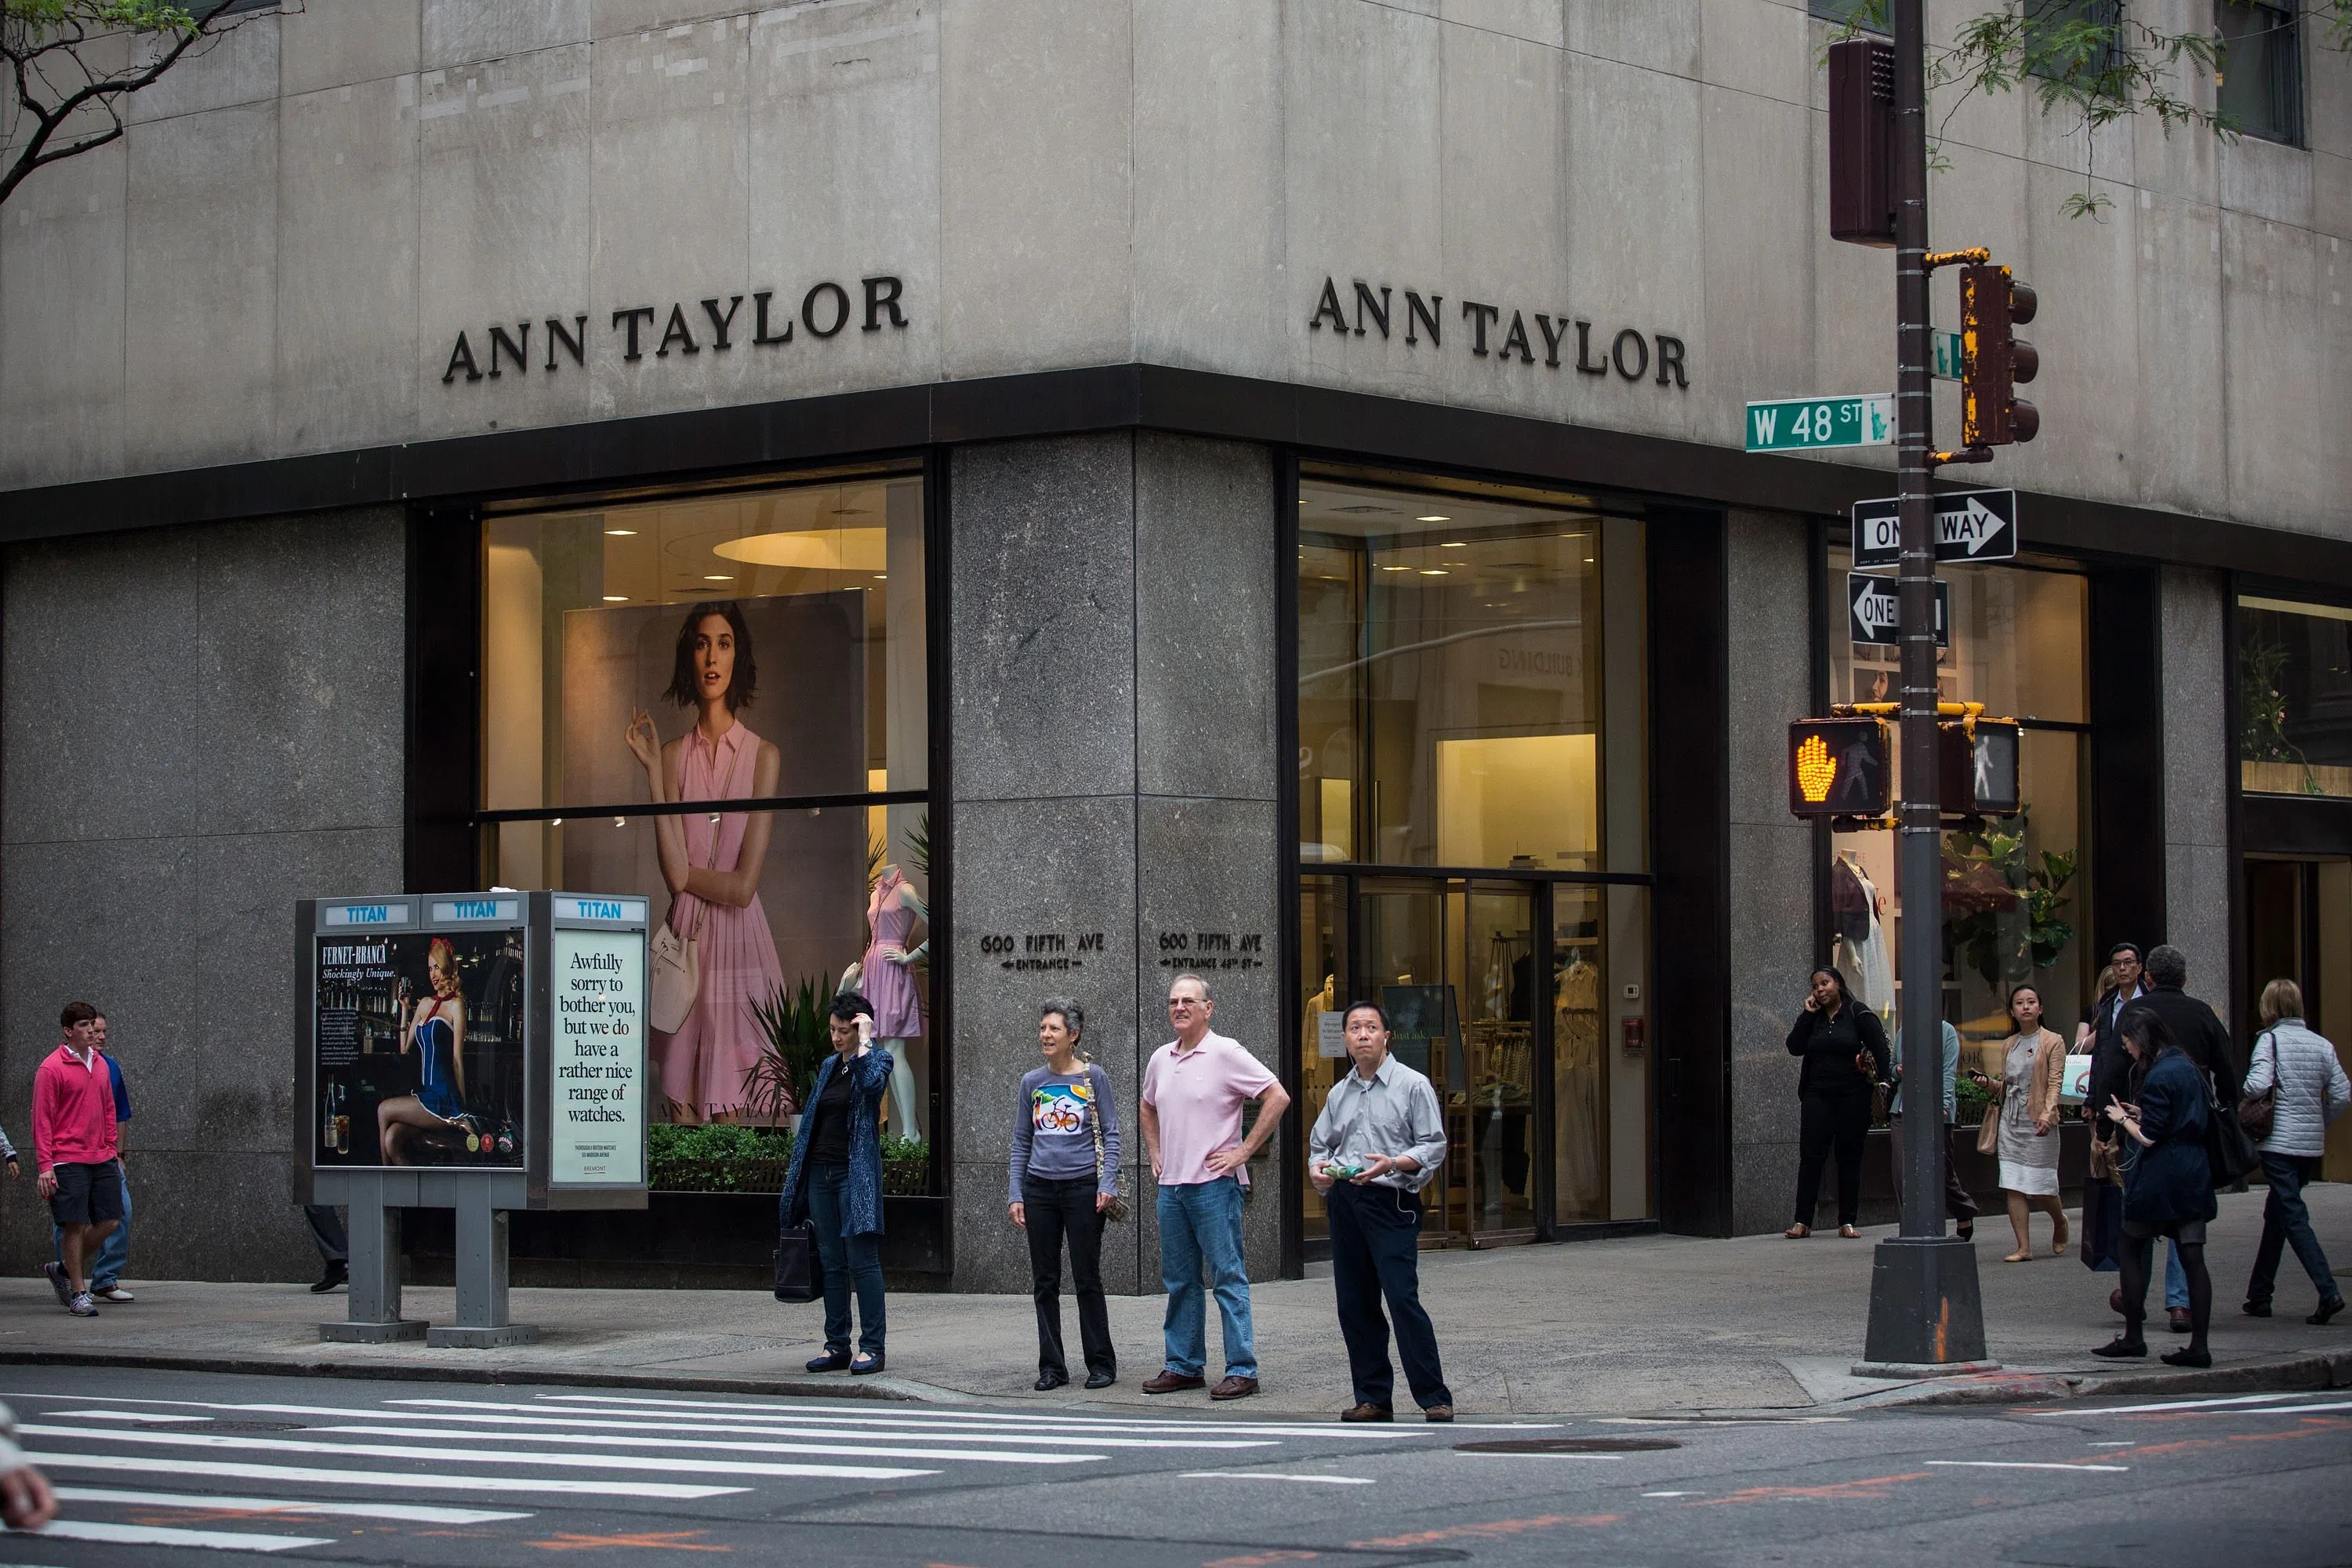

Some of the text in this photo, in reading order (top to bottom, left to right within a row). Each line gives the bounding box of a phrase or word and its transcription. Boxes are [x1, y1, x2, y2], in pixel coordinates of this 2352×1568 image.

[442, 276, 909, 383] ANN TAYLOR
[1310, 277, 1690, 387] ANN TAYLOR
[1755, 403, 1862, 445] W 48 ST
[1876, 513, 1989, 545] ON WAY
[1864, 597, 1895, 623] ONE
[347, 906, 387, 923] TITAN
[454, 901, 496, 919] TITAN
[578, 901, 622, 919] TITAN
[981, 933, 1104, 953] 600 FIFTH AVE
[1159, 932, 1261, 952] 600 FIFTH AVE
[322, 944, 386, 965] FERNET-BRANCA
[571, 952, 623, 974] Awfully
[1173, 957, 1217, 969] ENTRANCE
[1016, 958, 1069, 970] ENTRANCE
[322, 967, 396, 981] Shockingly Unique.
[571, 978, 623, 995] sorry to
[559, 995, 636, 1017] bother you,
[564, 1017, 630, 1035] but we do
[575, 1039, 619, 1057] have a
[559, 1062, 633, 1079] rather nice
[568, 1083, 626, 1104] range of
[568, 1105, 626, 1123] watches.
[657, 1102, 791, 1118] ANN TAYLOR
